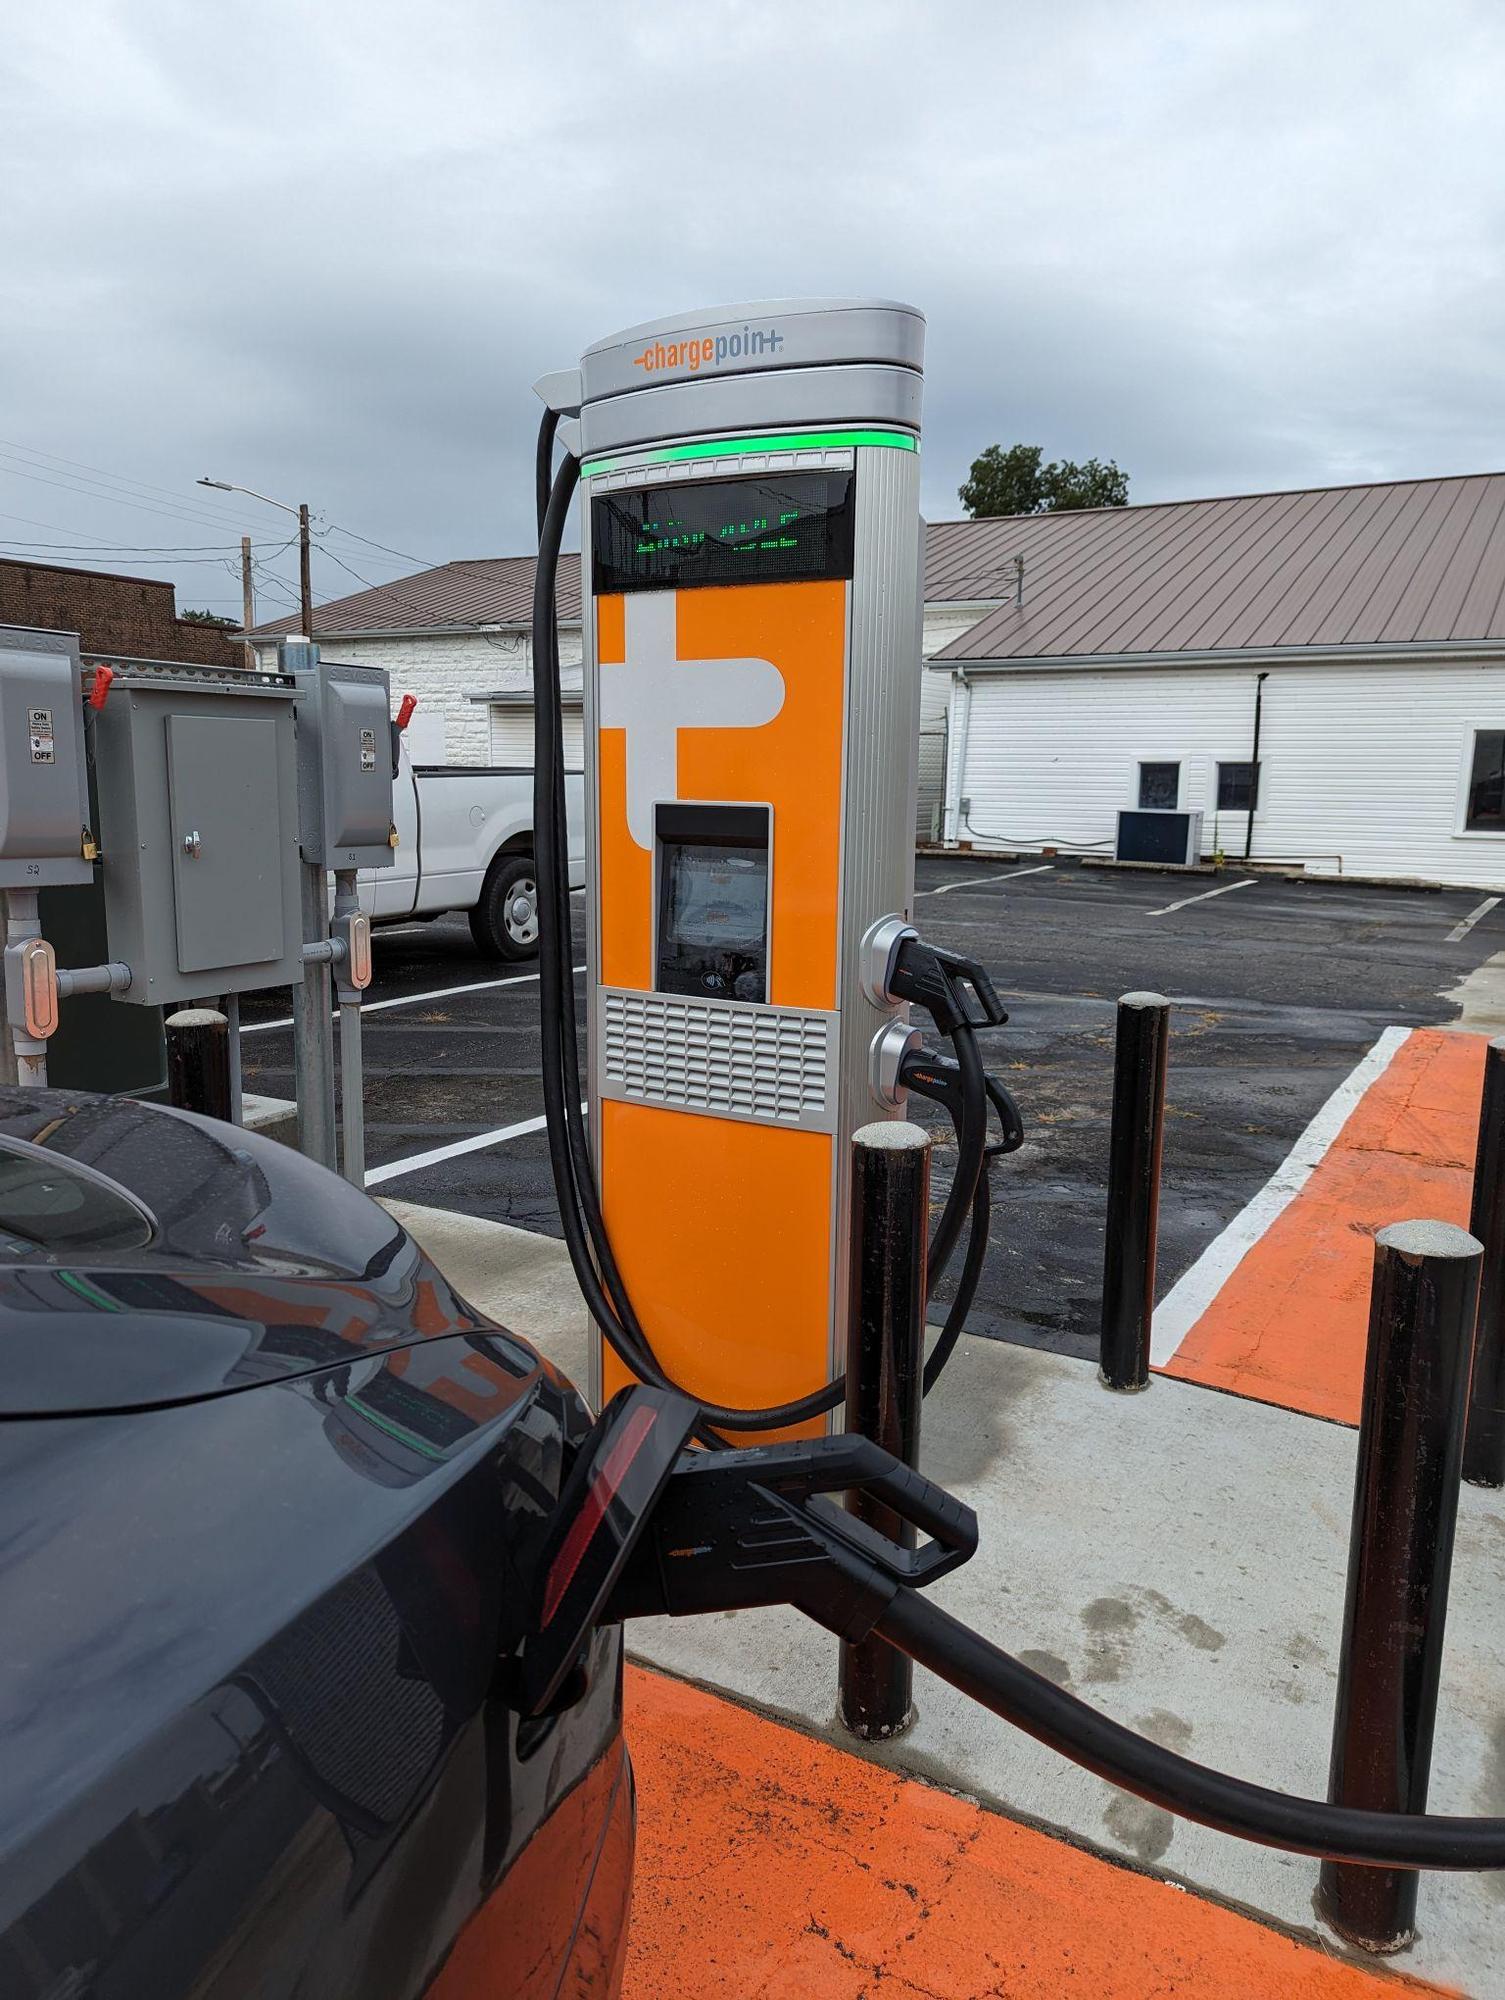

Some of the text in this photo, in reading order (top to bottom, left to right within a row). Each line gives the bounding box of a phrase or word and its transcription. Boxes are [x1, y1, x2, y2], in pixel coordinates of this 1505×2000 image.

[633, 325, 784, 371] chargepoint
[329, 667, 382, 684] SEMENS
[33, 712, 47, 721] ON
[34, 751, 52, 760] OFF
